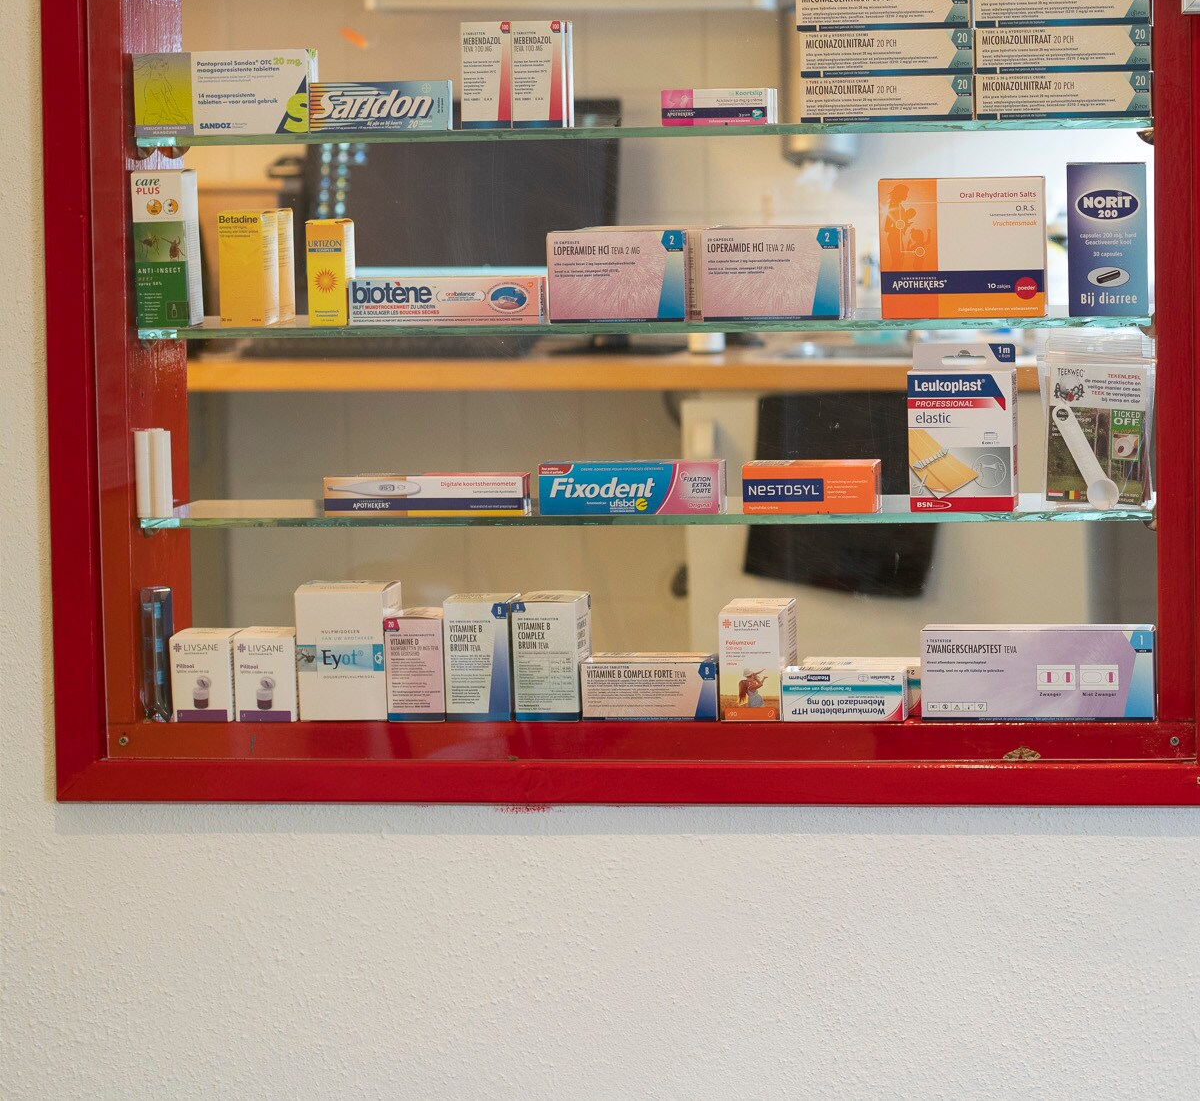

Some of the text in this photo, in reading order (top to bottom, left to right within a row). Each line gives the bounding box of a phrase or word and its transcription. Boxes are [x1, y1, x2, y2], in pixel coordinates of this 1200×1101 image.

[463, 37, 501, 45] MEBENDAZOL
[513, 36, 552, 45] MEBENDAZOL
[806, 39, 874, 49] MICONAZOLNITRAAT
[982, 35, 1051, 45] MICONAZOLNITRAAT
[806, 85, 874, 95] MICONAZOLNITRAAT
[982, 81, 1051, 91] MICONAZOLNITRAAT
[311, 90, 433, 119] Saridon
[135, 177, 160, 186] care
[136, 187, 160, 195] PLUS
[976, 191, 1017, 199] Rehydration
[1083, 195, 1132, 209] NORIT
[669, 235, 674, 245] 2
[824, 233, 830, 242] 2
[308, 240, 341, 248] URTIZON
[708, 243, 750, 253] LOPERAMIDE
[554, 246, 596, 255] LOPERAMIDE
[892, 280, 944, 290] APOTHEKERS
[352, 281, 432, 304] biotène
[1080, 293, 1137, 306] Bij diarree
[1058, 368, 1083, 377] TEEKWEG
[915, 379, 982, 393] Leukoplast
[915, 411, 951, 424] elastic
[550, 477, 655, 498] Fixodent
[449, 625, 477, 633] VITAMINE
[450, 634, 477, 642] COMPLEX
[518, 632, 545, 640] COMPLEX
[390, 638, 412, 646] VITAMINE
[518, 641, 537, 649] BRUIN
[184, 644, 218, 652] LIVSANE
[248, 644, 284, 652] LIVSANE
[450, 643, 468, 652] BRUIN
[927, 644, 1017, 654] ZWANGERSCHAPSTEST TEVA
[322, 649, 358, 669] Eyot
[587, 669, 673, 679] VITAMINE B COMPLEX FORTE
[811, 707, 885, 715] Wormkuurtabletten
